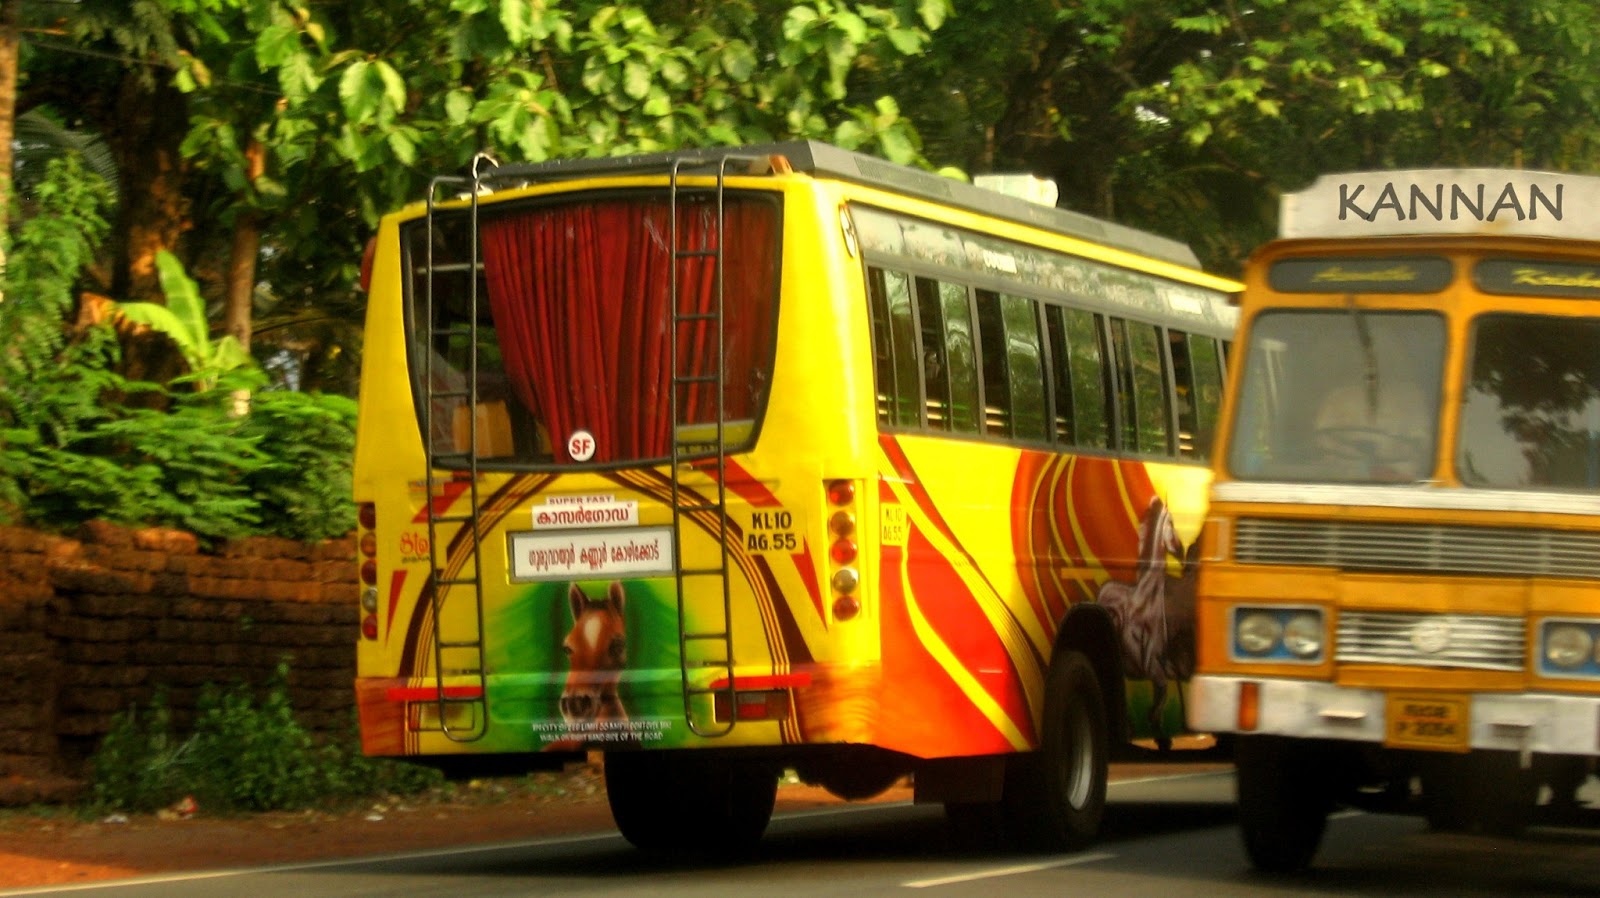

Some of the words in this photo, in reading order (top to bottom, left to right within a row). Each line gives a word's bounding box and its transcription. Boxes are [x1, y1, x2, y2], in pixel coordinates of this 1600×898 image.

[1338, 182, 1564, 222] KANNAN
[571, 439, 591, 455] SF
[586, 495, 612, 503] FAST
